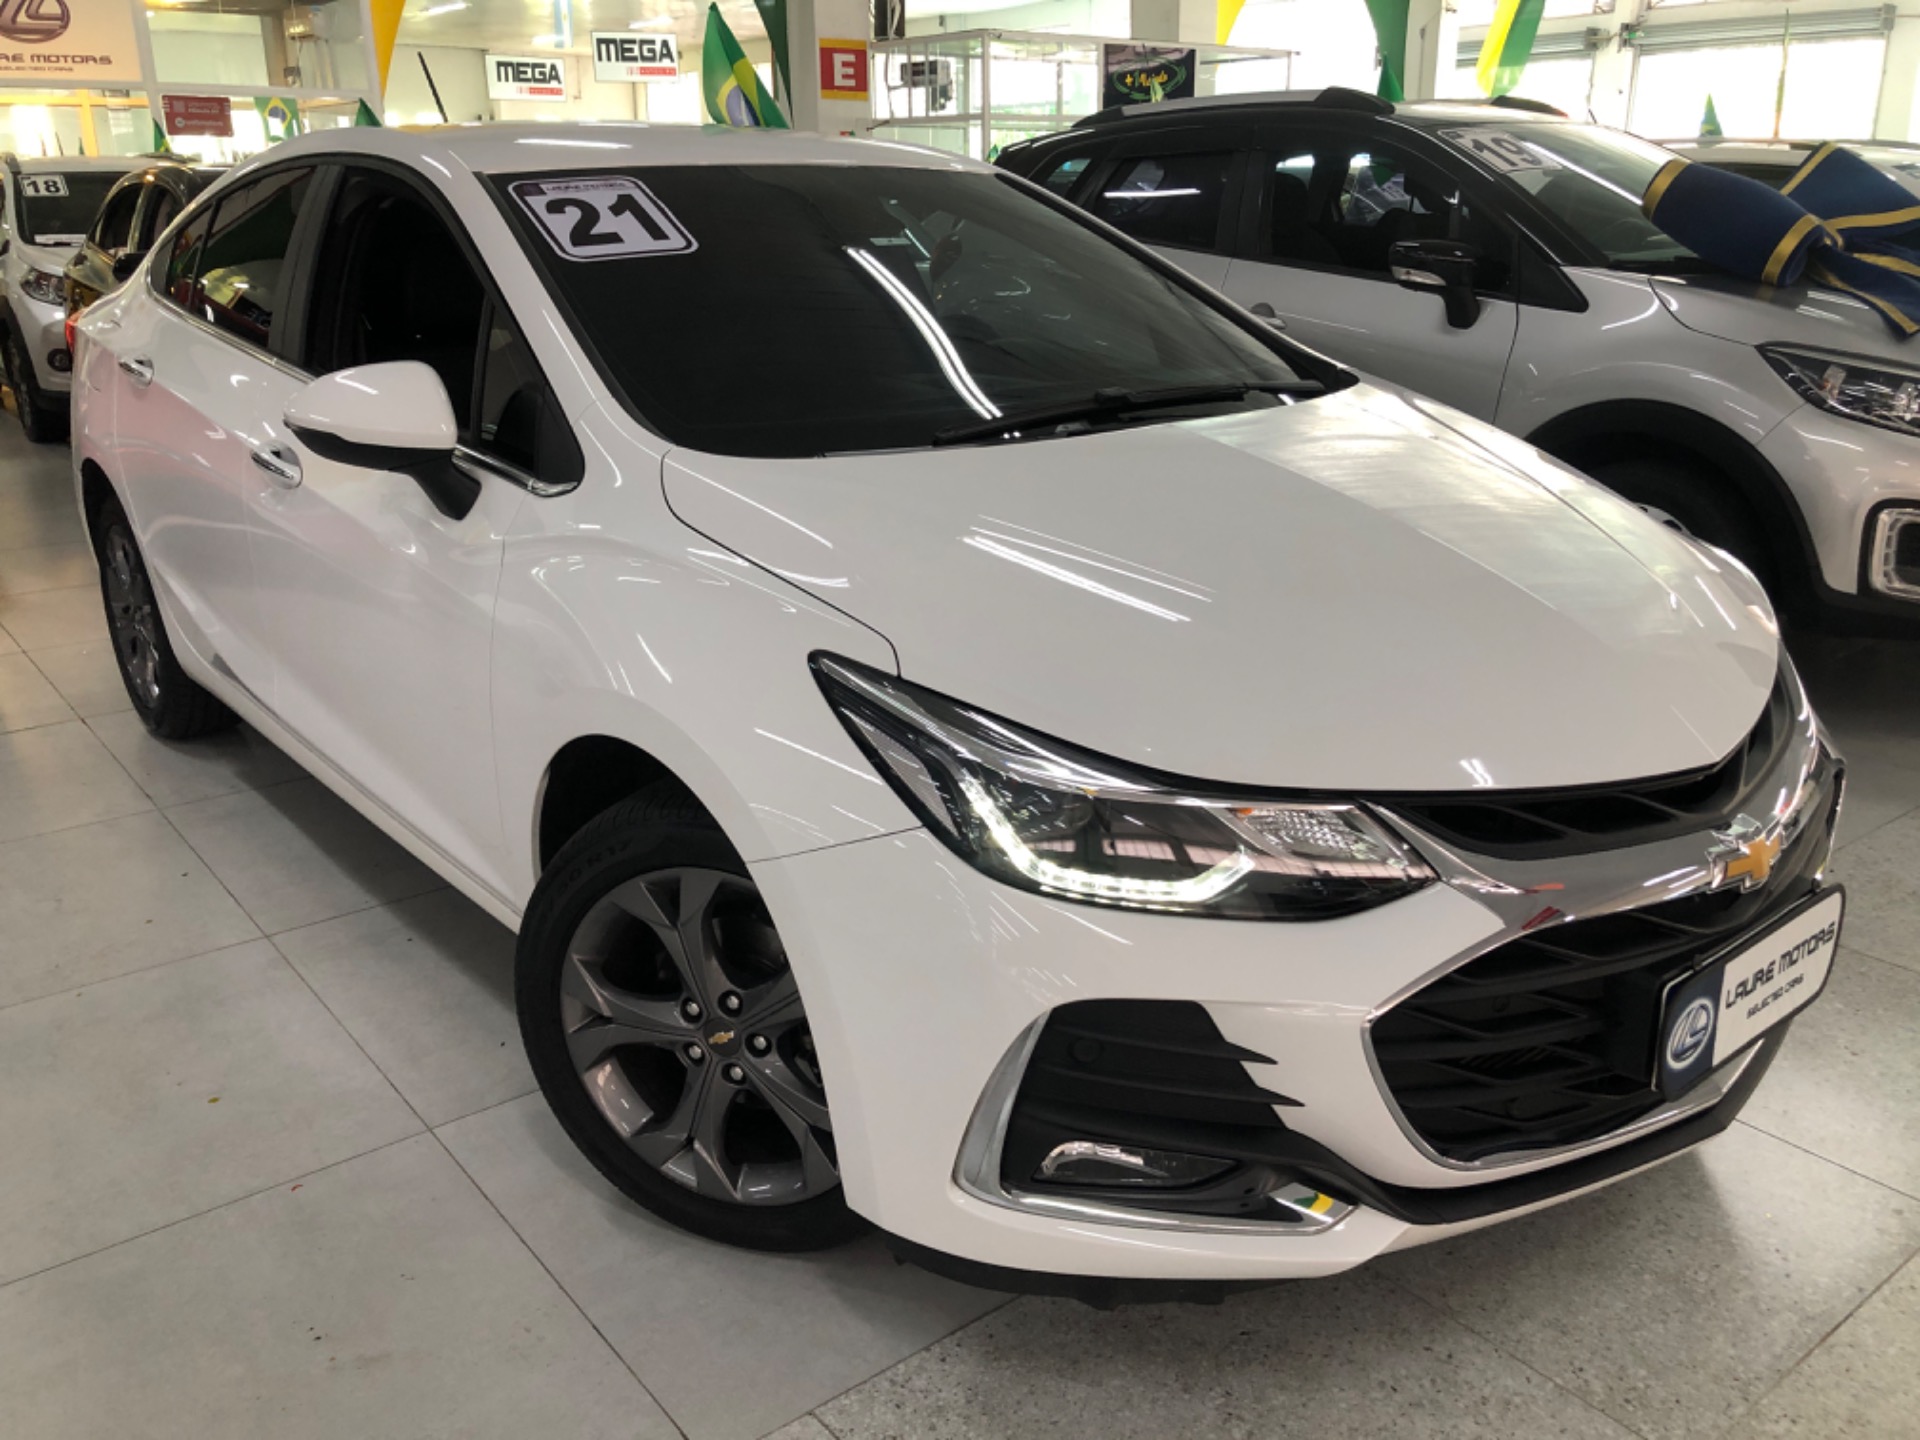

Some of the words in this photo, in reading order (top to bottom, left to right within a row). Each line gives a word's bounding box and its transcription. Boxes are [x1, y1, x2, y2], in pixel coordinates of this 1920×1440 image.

[30, 54, 113, 66] MOTORS
[596, 38, 675, 63] MEGA
[496, 60, 562, 84] MEGA
[833, 53, 857, 87] E
[1470, 136, 1543, 167] 19
[26, 180, 61, 194] 18
[545, 193, 672, 248] 21
[1726, 960, 1776, 1009] LAURE
[1778, 921, 1835, 974] MOTORS
